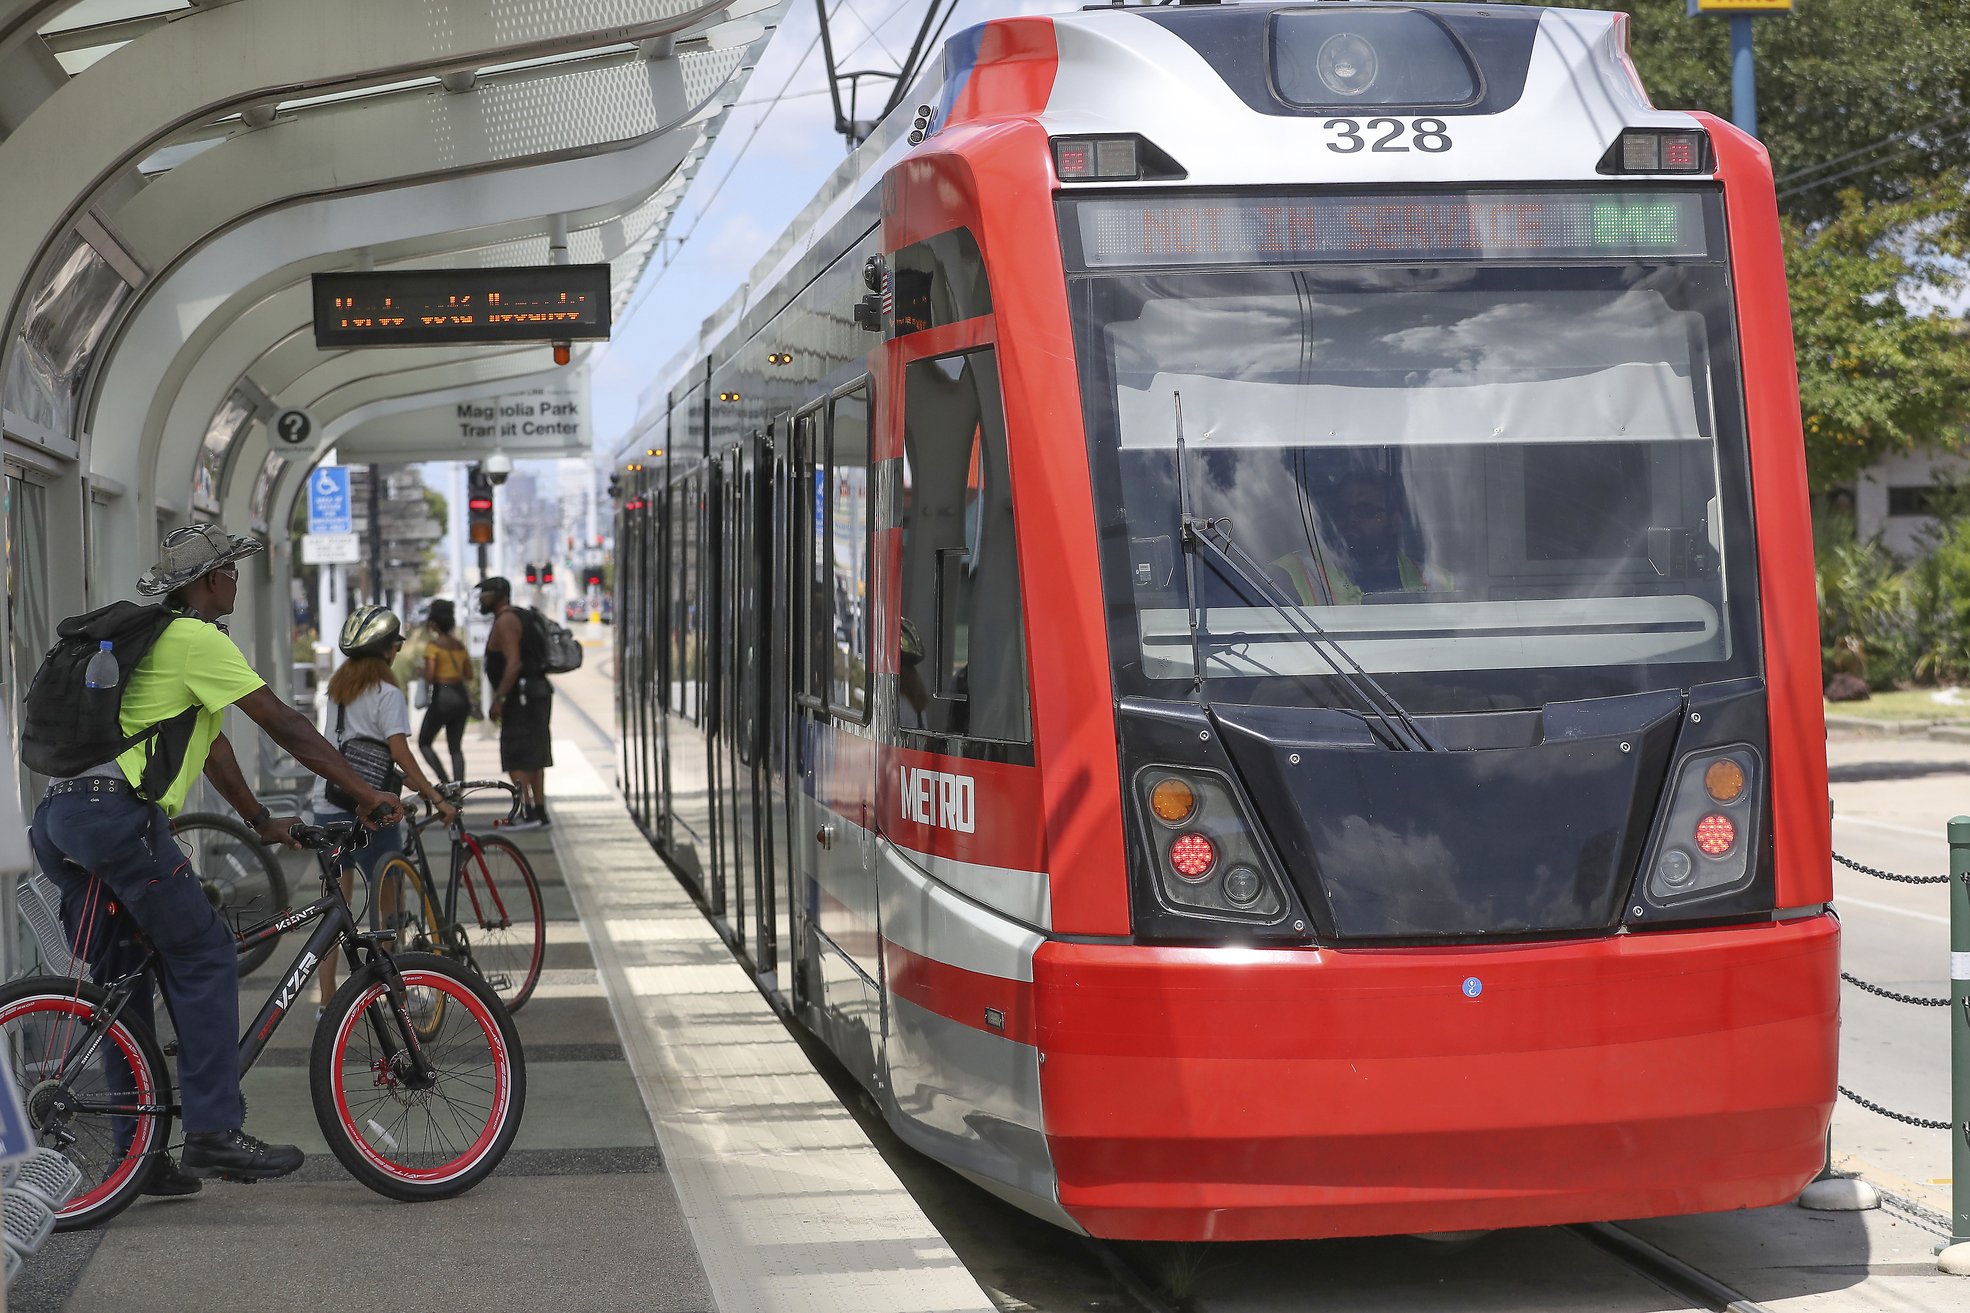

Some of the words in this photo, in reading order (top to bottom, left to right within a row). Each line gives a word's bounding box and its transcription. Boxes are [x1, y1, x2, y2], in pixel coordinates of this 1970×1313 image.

[1323, 117, 1453, 153] 328
[1143, 207, 1224, 252] NOT
[1260, 206, 1317, 251] IN
[1346, 204, 1544, 250] SERVICE
[540, 401, 579, 416] Park
[522, 421, 579, 436] Center
[900, 765, 975, 834] METRO
[275, 905, 317, 931] KENT
[275, 951, 319, 1010] KZR
